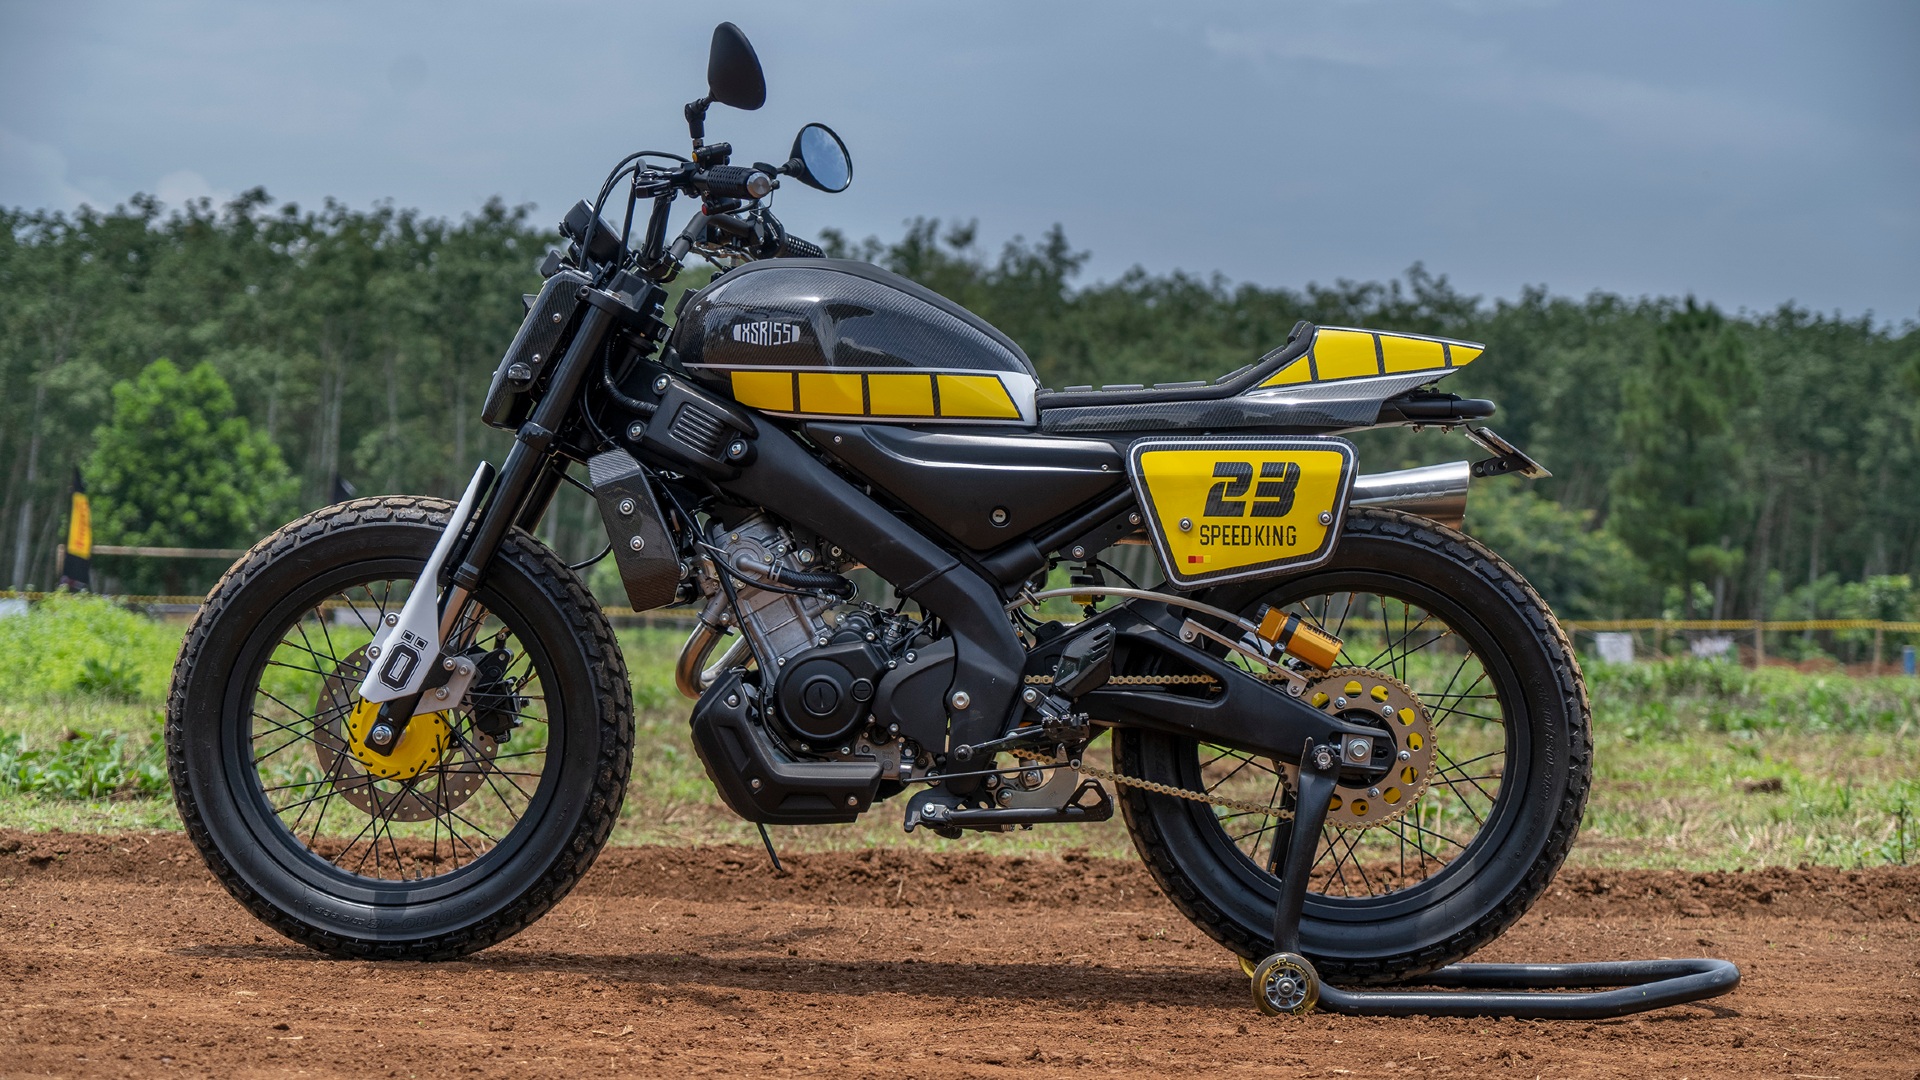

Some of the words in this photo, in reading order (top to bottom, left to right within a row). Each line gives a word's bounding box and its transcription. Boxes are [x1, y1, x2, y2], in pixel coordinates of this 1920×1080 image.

[1203, 461, 1301, 517] 23
[1199, 525, 1251, 546] SPEED
[1255, 525, 1297, 546] KING
